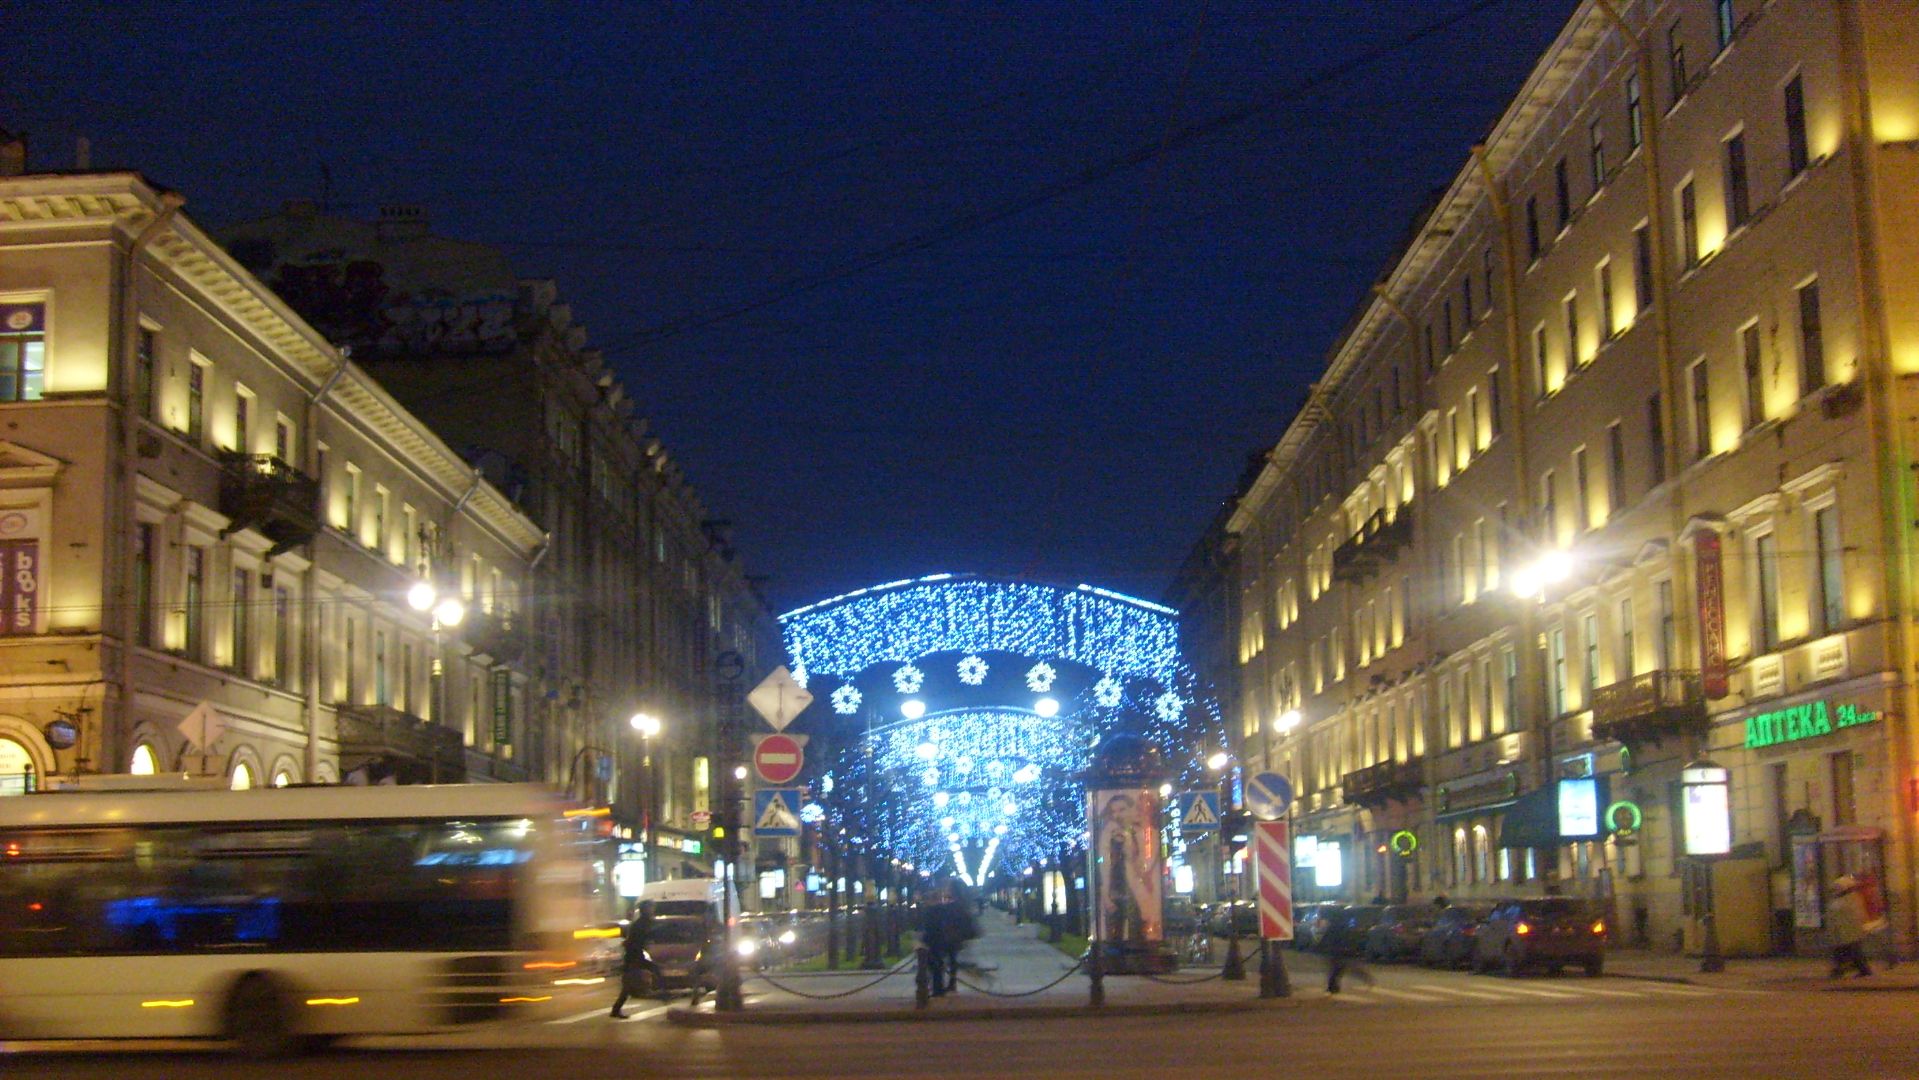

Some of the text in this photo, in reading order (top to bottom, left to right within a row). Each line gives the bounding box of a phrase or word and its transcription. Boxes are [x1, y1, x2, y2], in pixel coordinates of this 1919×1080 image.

[17, 551, 36, 627] books
[1744, 700, 1832, 748] АПТЕКА
[1836, 704, 1856, 727] 24
